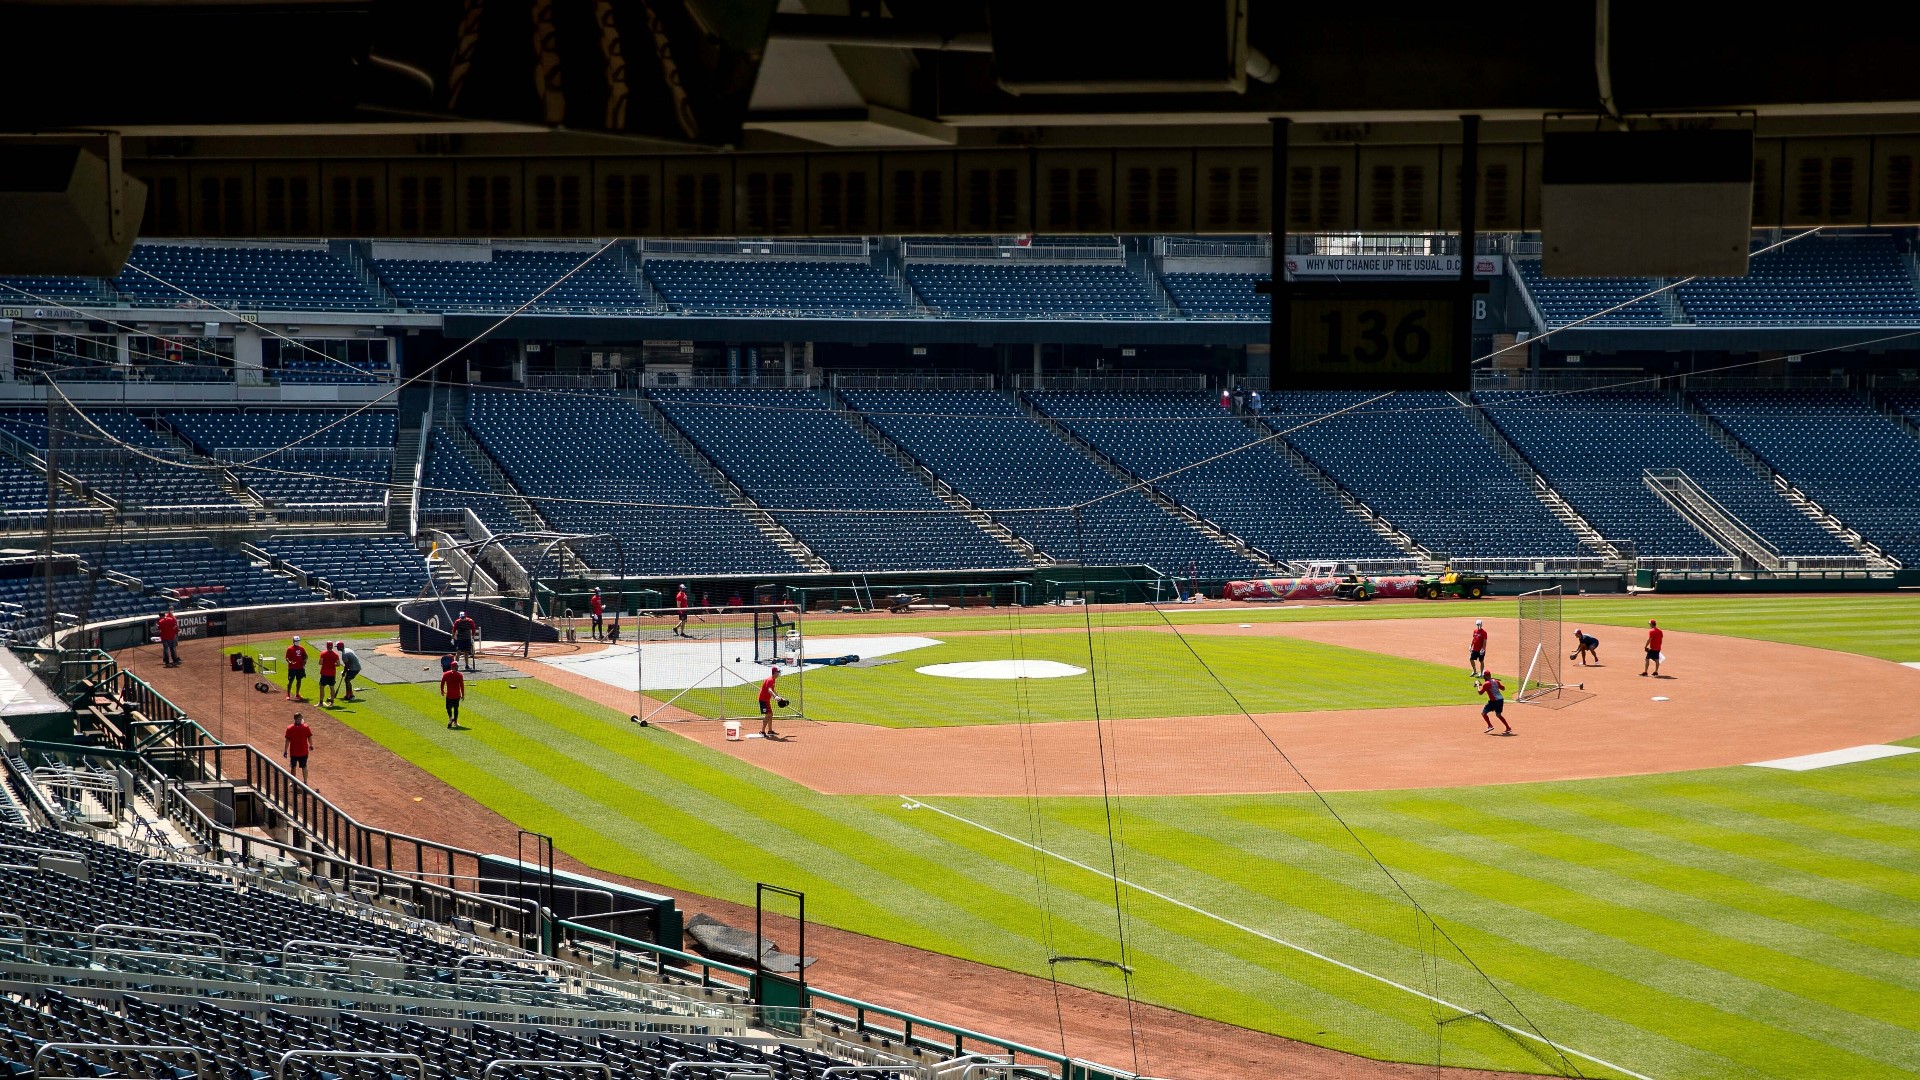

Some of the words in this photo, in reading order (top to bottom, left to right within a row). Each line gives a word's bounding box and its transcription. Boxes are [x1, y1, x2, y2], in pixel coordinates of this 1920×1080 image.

[1306, 259, 1325, 270] WHY
[1328, 259, 1344, 270] NOT
[1346, 259, 1380, 270] CHANGE
[1382, 259, 1394, 270] UP
[1396, 259, 1412, 270] THE
[5, 309, 19, 317] 120
[46, 310, 83, 319] RAINES
[1471, 299, 1487, 320] B
[1319, 310, 1429, 363] 136
[177, 616, 207, 627] TIONALS
[178, 627, 197, 637] PARK
